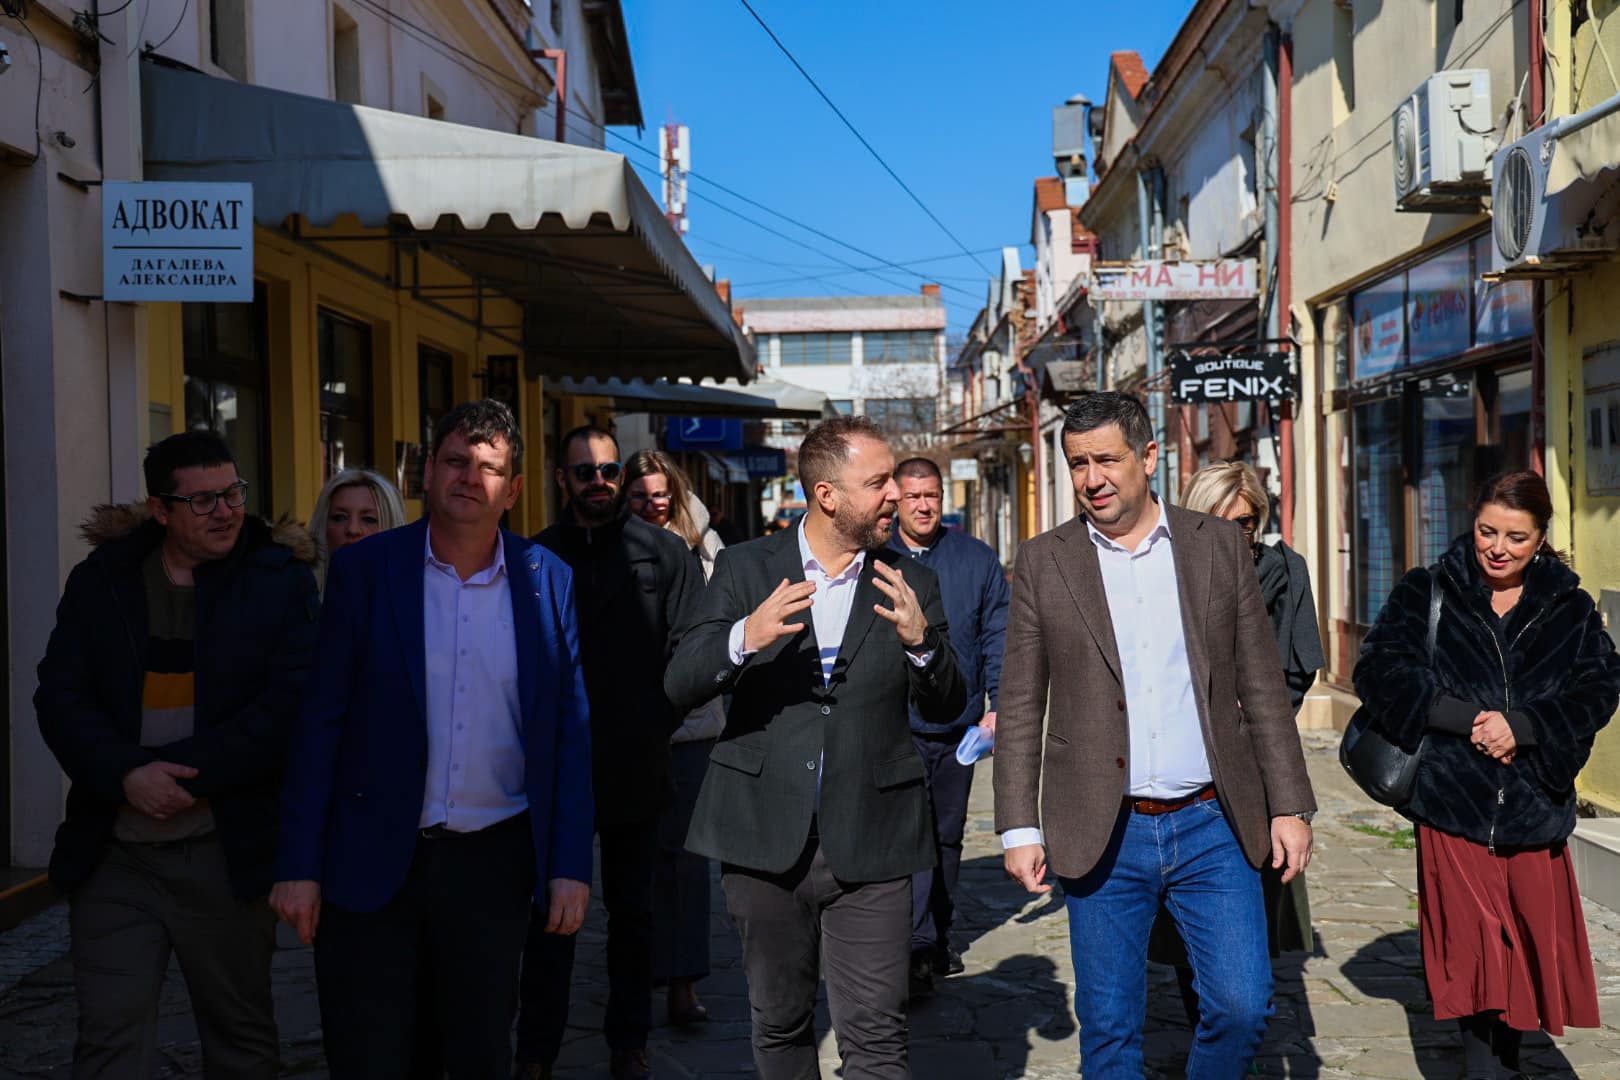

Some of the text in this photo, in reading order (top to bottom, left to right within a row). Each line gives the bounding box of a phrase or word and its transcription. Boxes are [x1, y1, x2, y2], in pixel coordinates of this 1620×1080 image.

[112, 199, 243, 237] АДВОКАТ
[131, 258, 226, 271] ДАГАЛЕВА
[119, 273, 237, 286] АЛЕКСАНДРА
[1194, 359, 1264, 375] BOUTIQUE
[1180, 375, 1283, 399] FENIX
